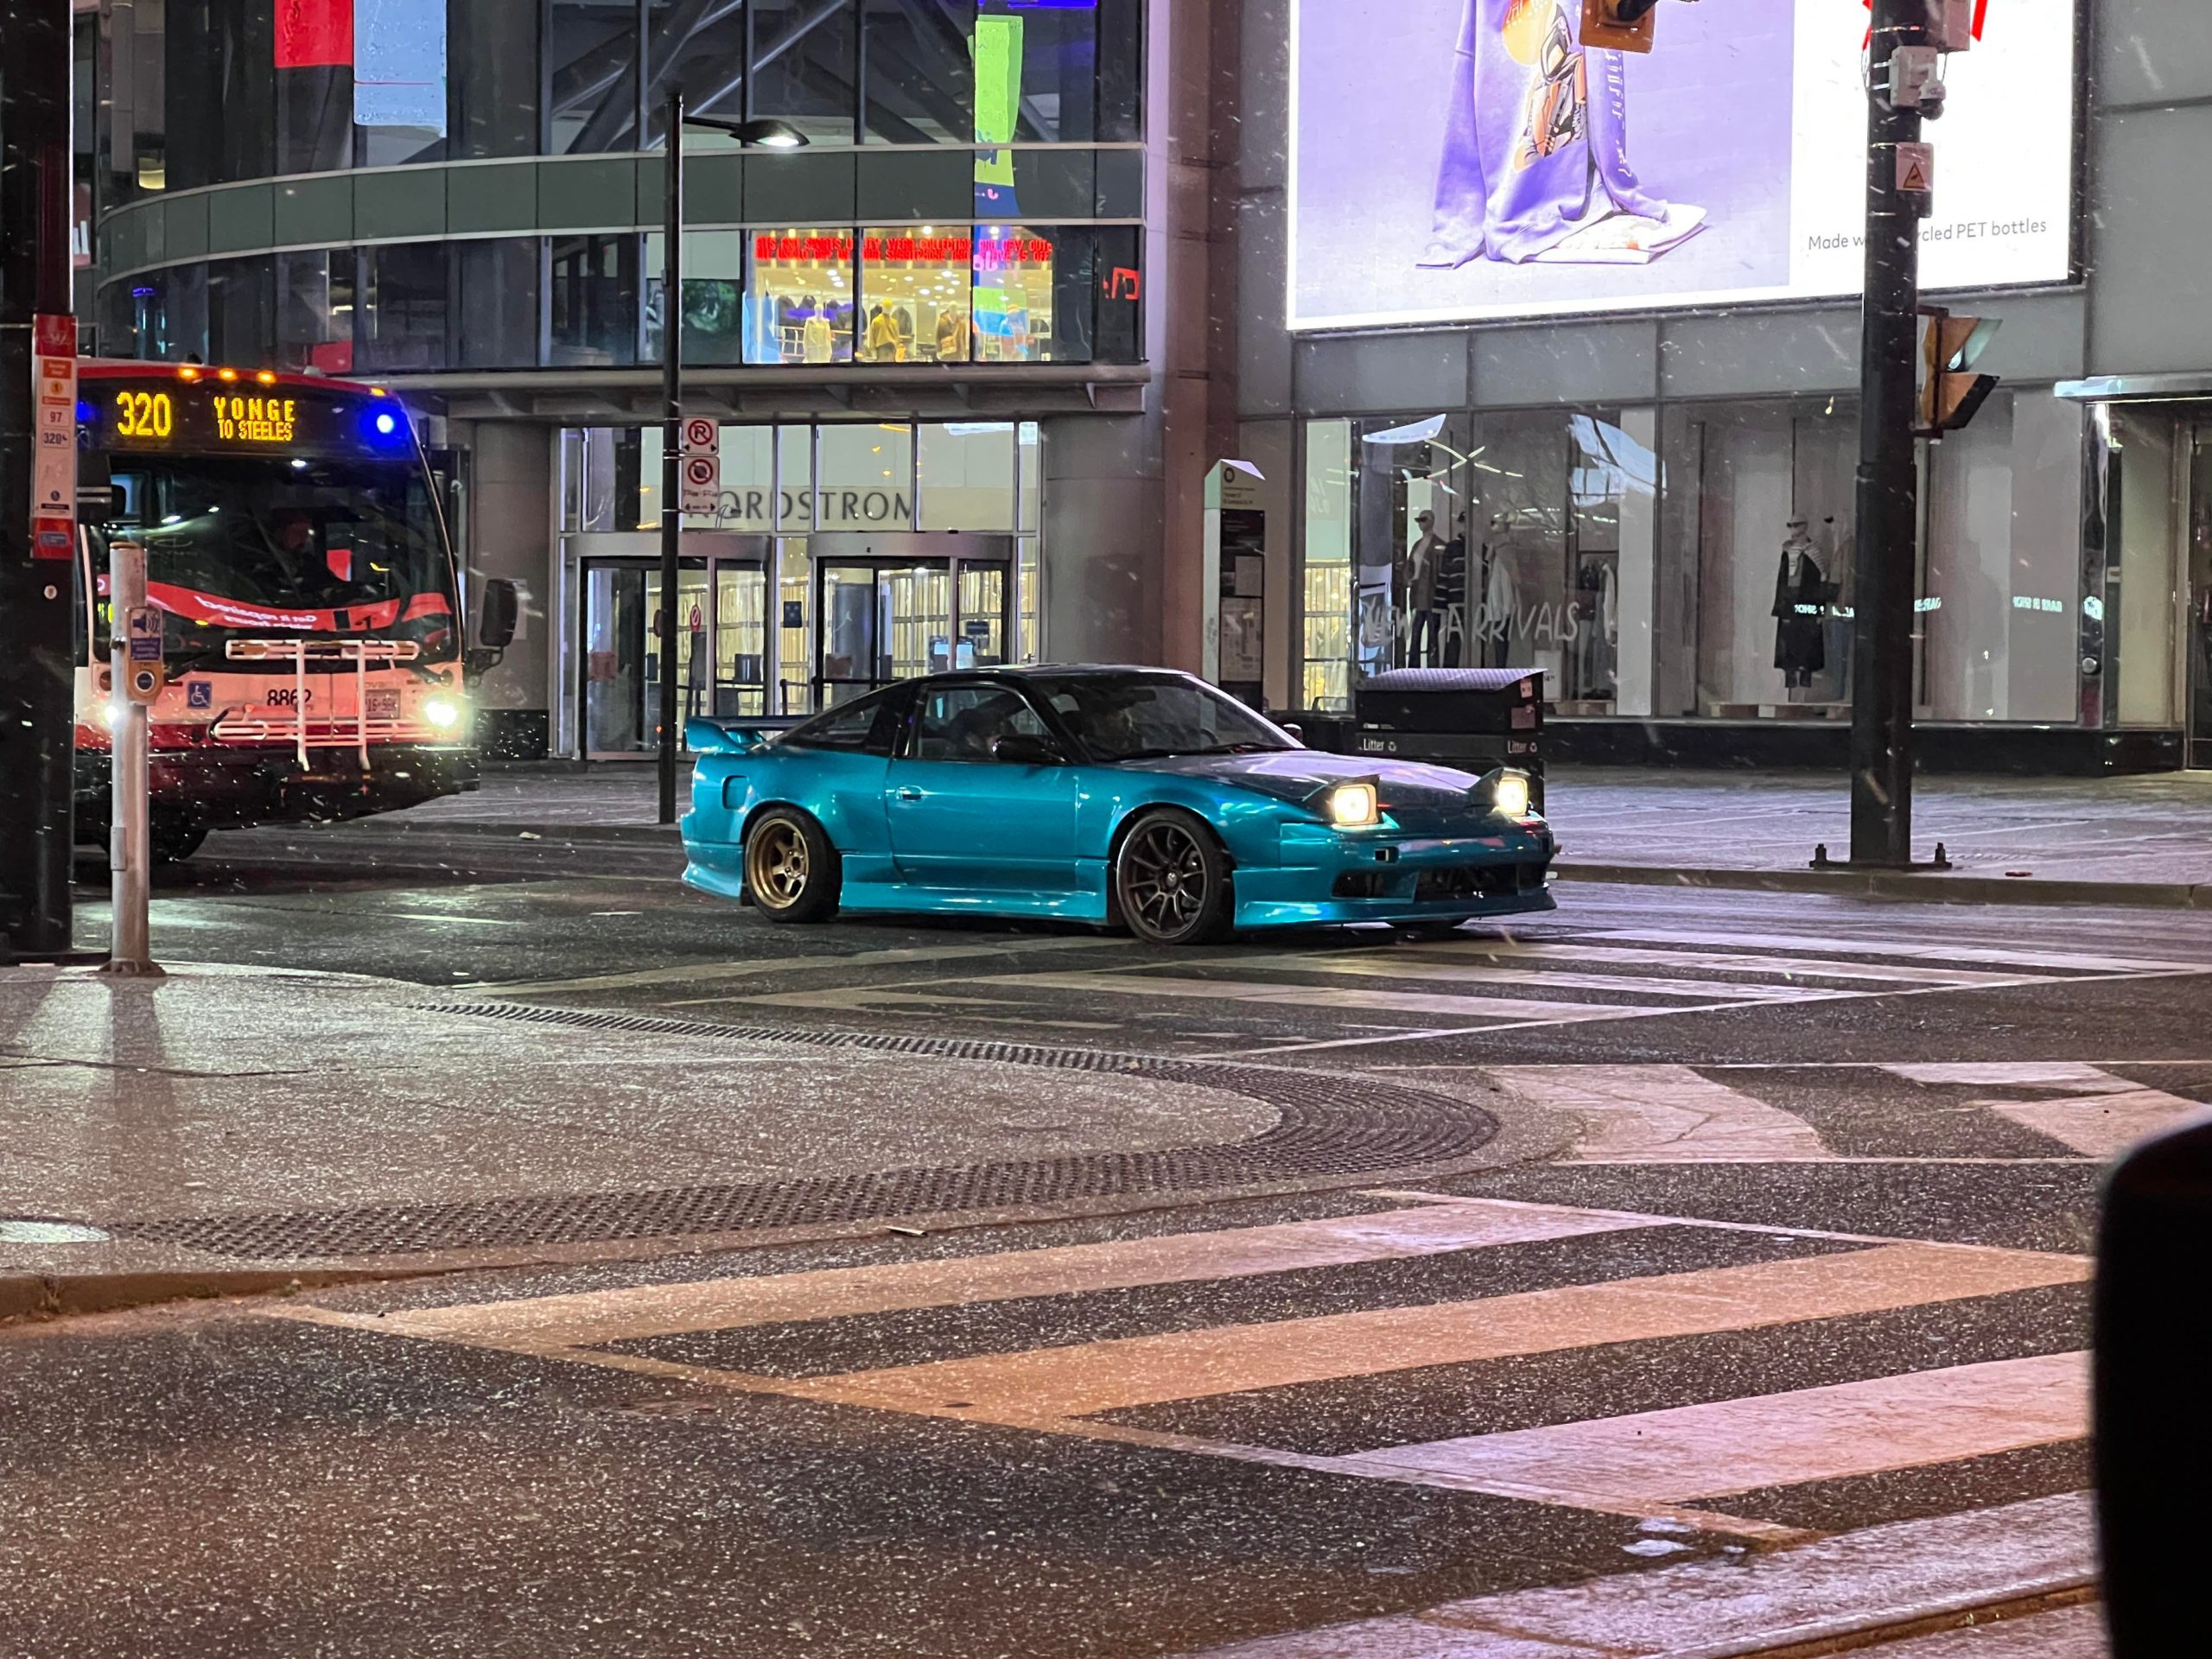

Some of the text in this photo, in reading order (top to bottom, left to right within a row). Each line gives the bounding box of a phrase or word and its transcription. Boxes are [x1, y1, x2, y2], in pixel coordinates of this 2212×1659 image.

[1808, 234, 1848, 250] Made
[1956, 222, 1986, 238] PET
[1991, 219, 2046, 236] bottles
[49, 411, 62, 423] 97
[117, 392, 295, 436] 320 YONGE
[217, 419, 293, 442] TO STEELES
[43, 432, 61, 444] 320
[1363, 738, 1384, 752] Litter
[1507, 740, 1527, 753] Litter
